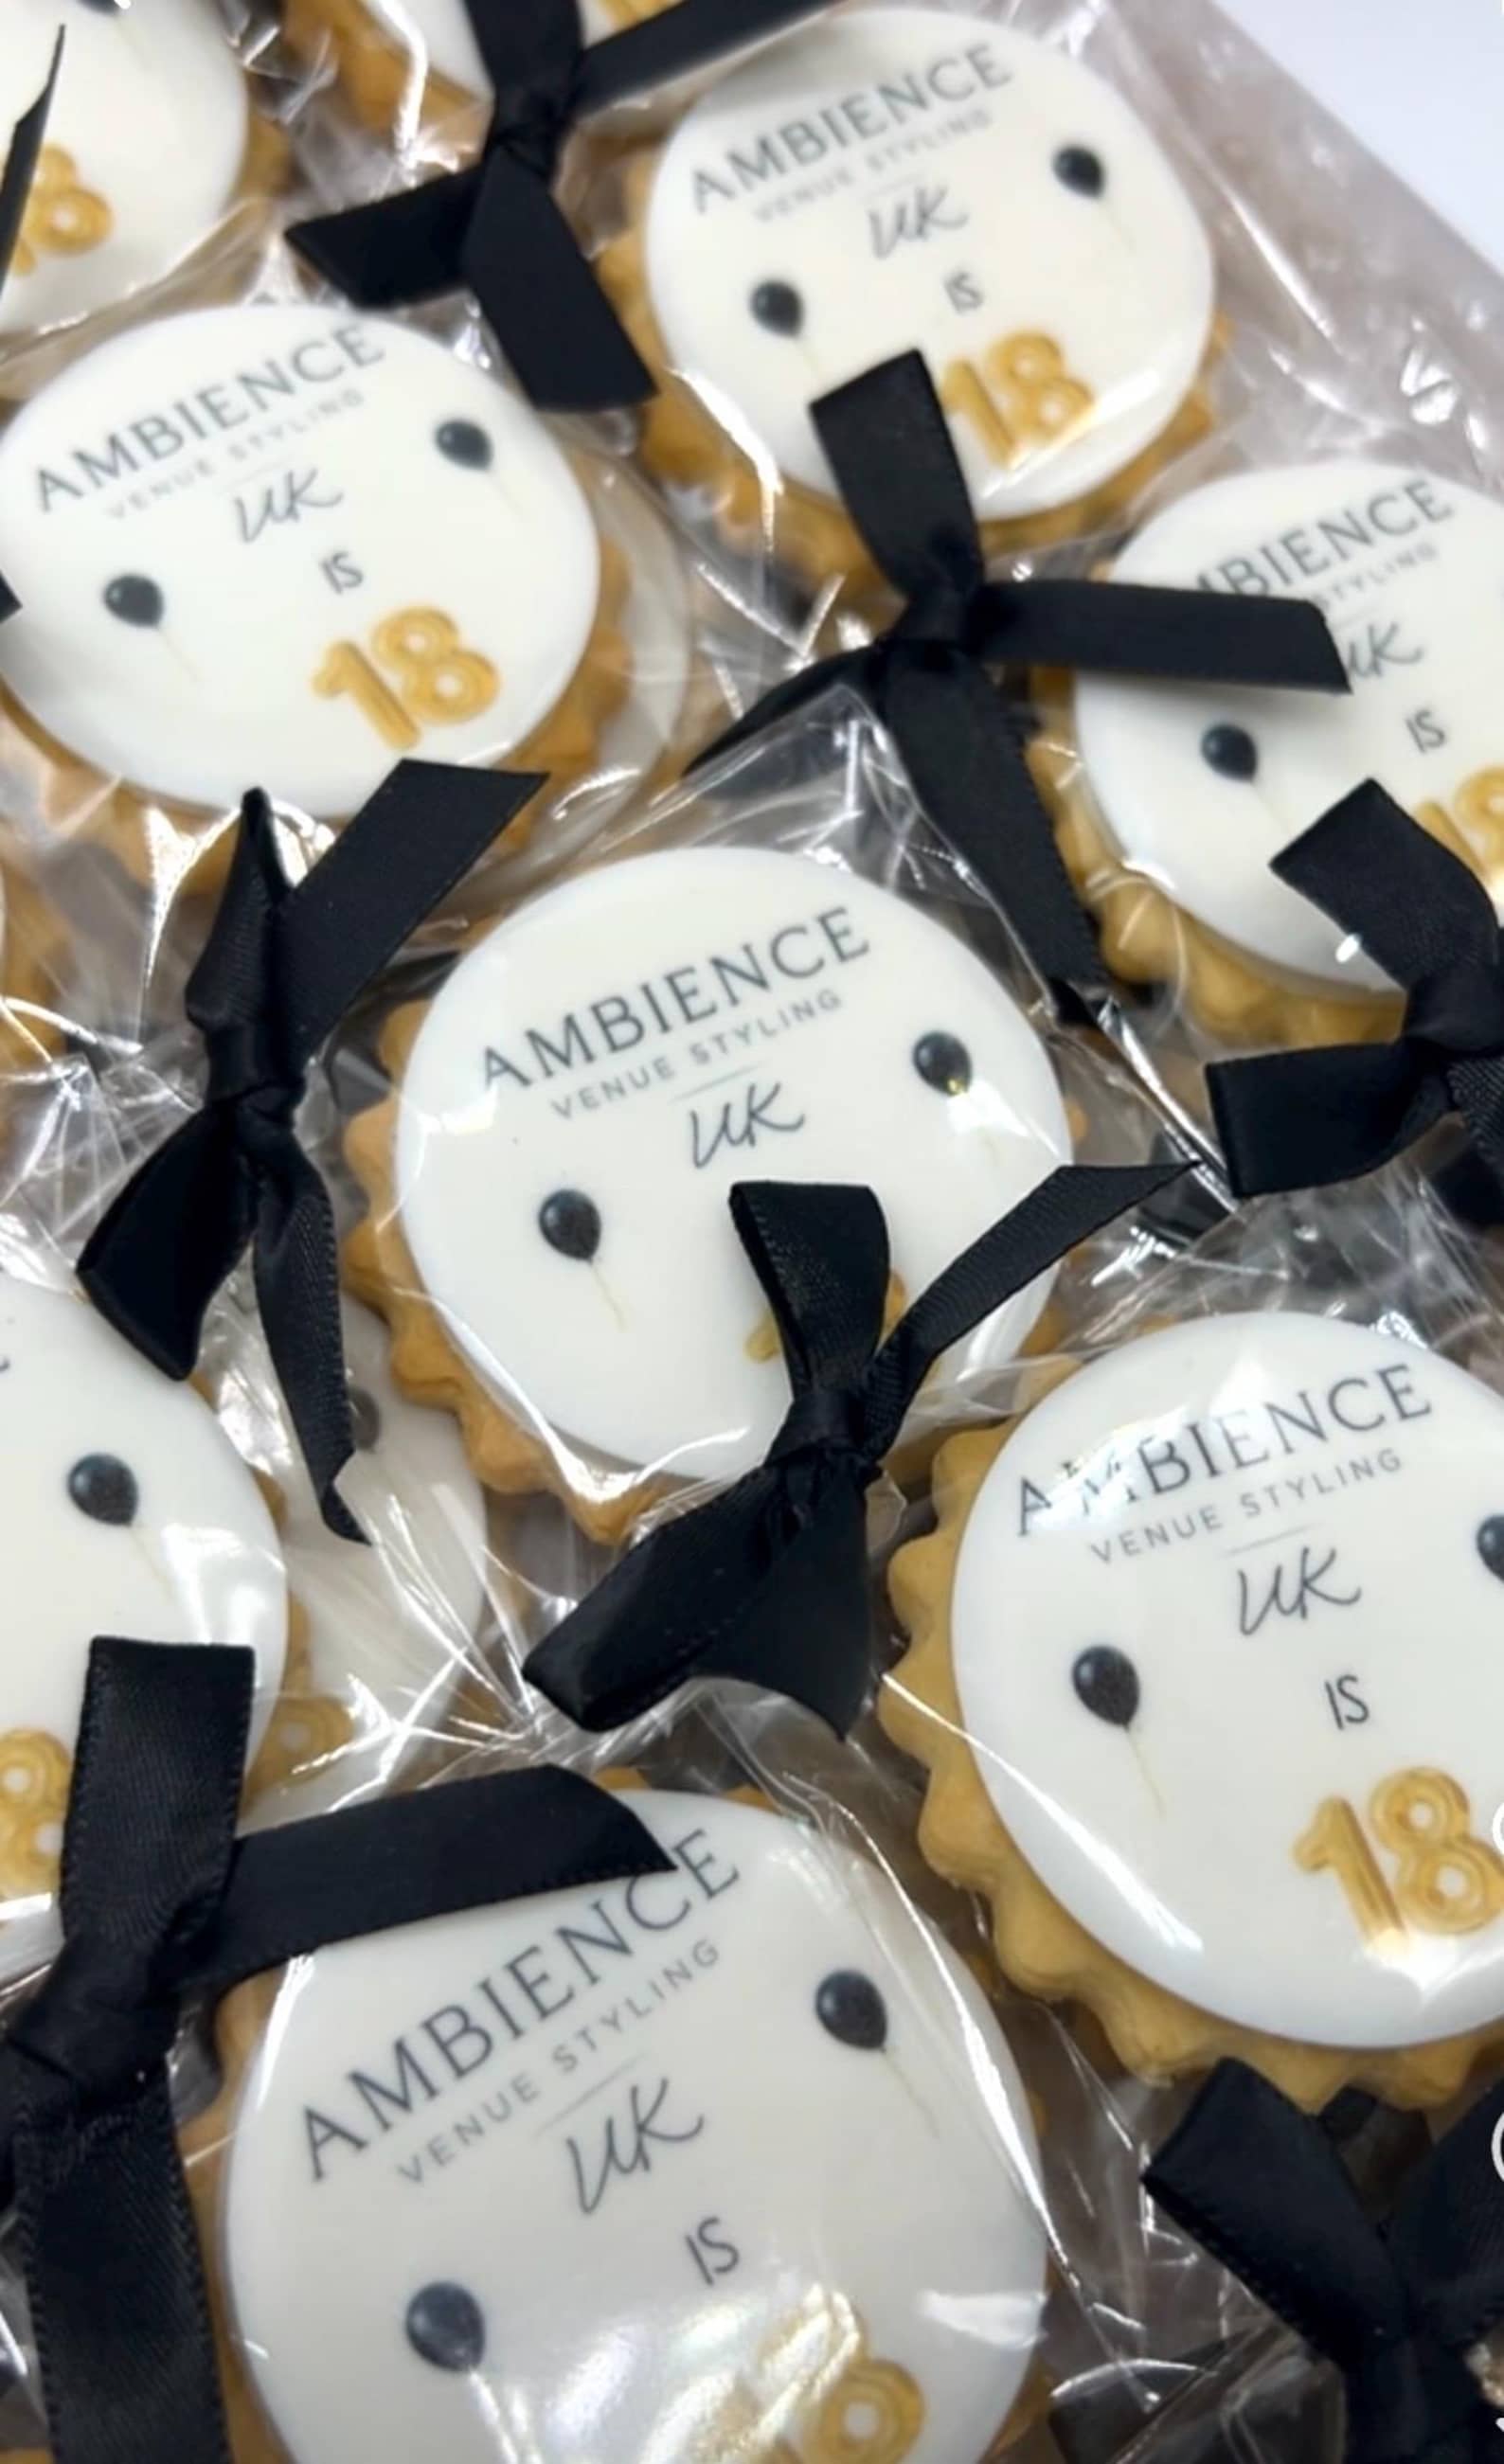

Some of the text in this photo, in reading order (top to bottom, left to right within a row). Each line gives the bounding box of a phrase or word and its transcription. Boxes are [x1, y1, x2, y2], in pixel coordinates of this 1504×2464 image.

[692, 43, 1014, 214] AMBIENCE
[868, 187, 969, 259] UK
[944, 269, 984, 314] IS
[35, 323, 385, 513] AMBIENCE
[228, 386, 365, 465] STYLING
[234, 468, 344, 544] UK
[1195, 475, 1456, 597] BIENCE
[318, 549, 365, 595] IS
[312, 605, 501, 752] 18
[1406, 709, 1447, 754] IS
[480, 904, 871, 1094] AMBIENCE
[550, 988, 843, 1120] VENUE STYLING
[689, 1081, 806, 1170] UK
[1090, 1447, 1404, 1566] VENUE STYLING
[1236, 1544, 1362, 1636] UK
[1325, 1673, 1370, 1731] IS
[1291, 1765, 1504, 1955] 18
[298, 1828, 741, 2181] AMBIENCE
[398, 1937, 723, 2186] VENUE STYLING
[565, 2078, 705, 2215] UK
[683, 2216, 742, 2285] IS
